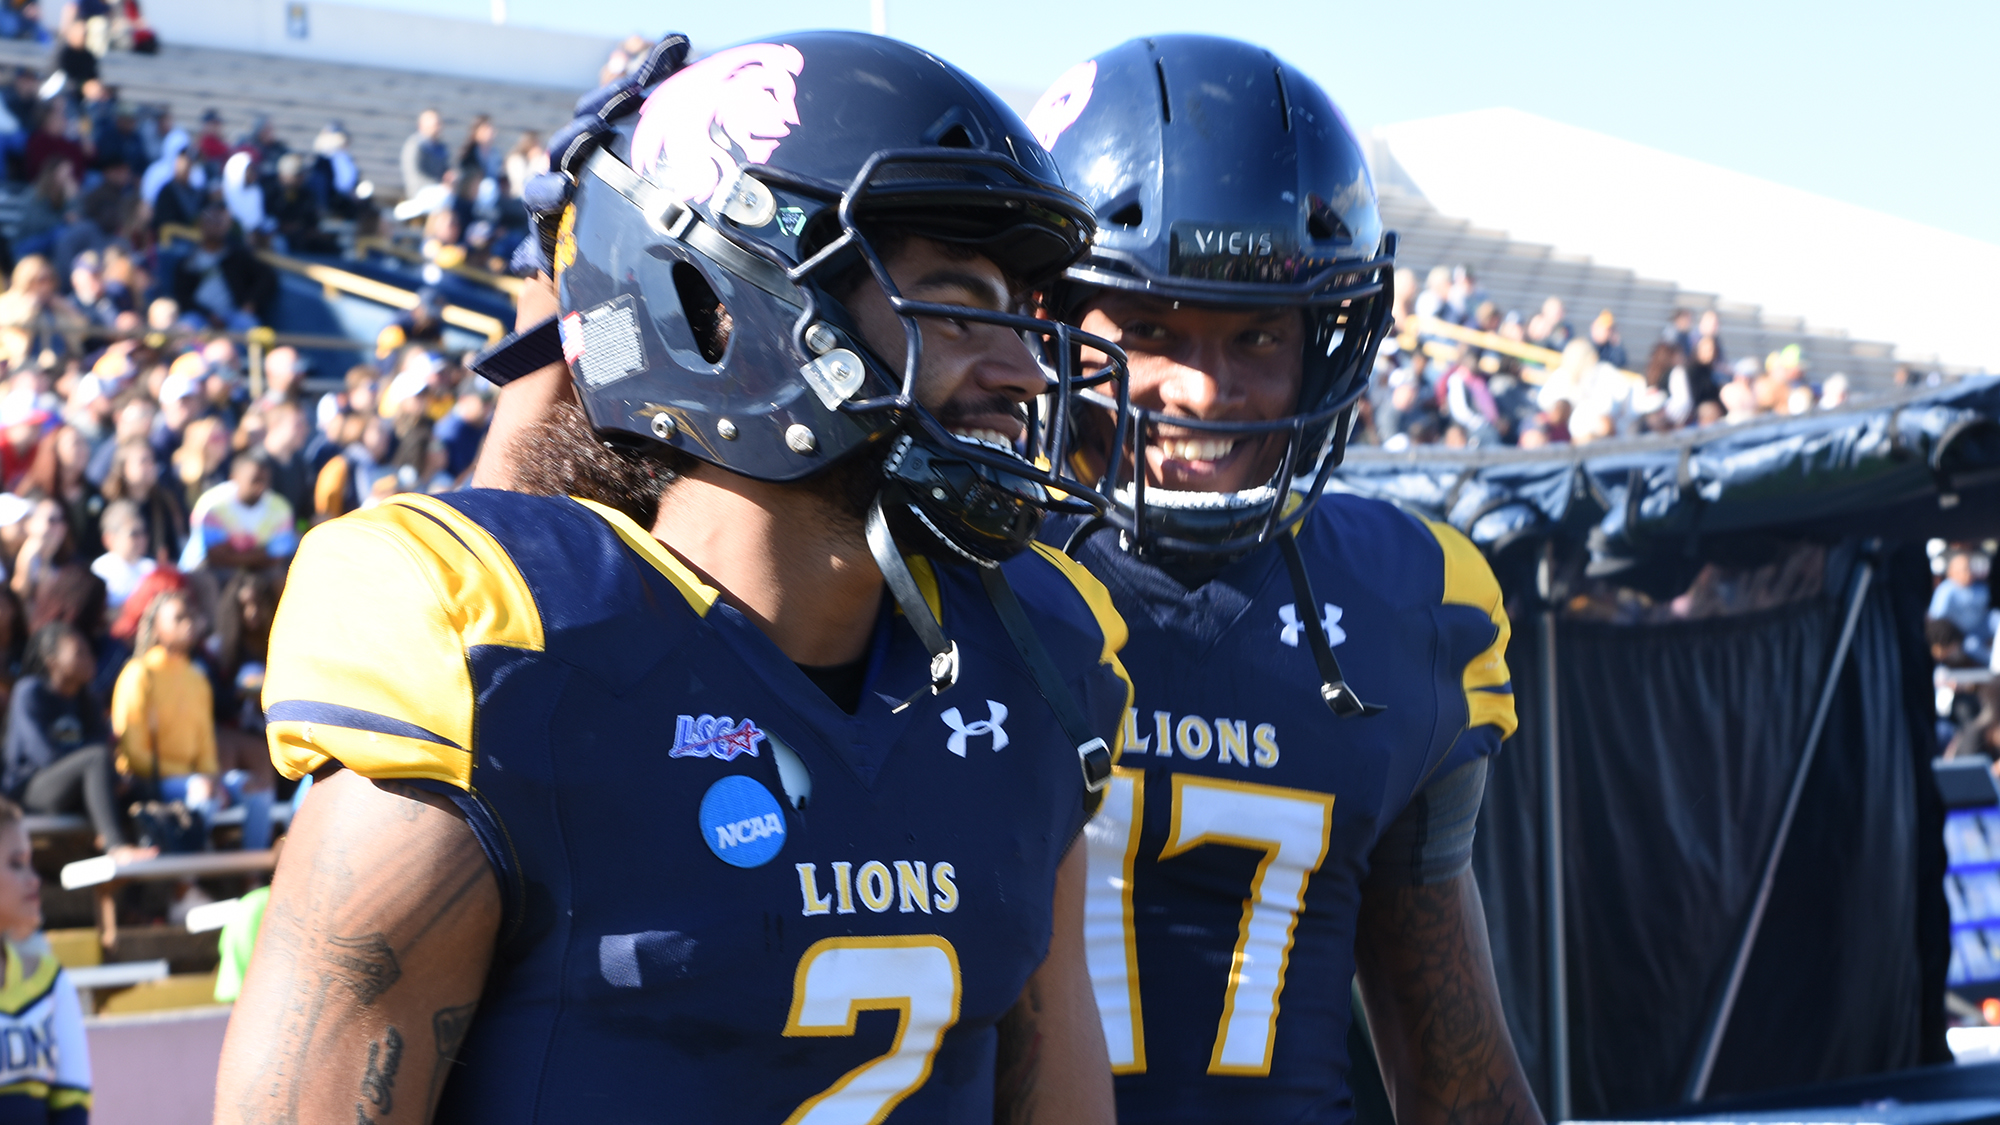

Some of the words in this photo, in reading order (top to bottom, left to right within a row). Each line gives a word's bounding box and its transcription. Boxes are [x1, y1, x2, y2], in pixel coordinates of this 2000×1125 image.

[1195, 229, 1272, 256] VICIS
[1124, 707, 1280, 768] LIONS
[715, 812, 785, 849] NCAA
[795, 860, 960, 916] LIONS
[781, 934, 963, 1125] 2
